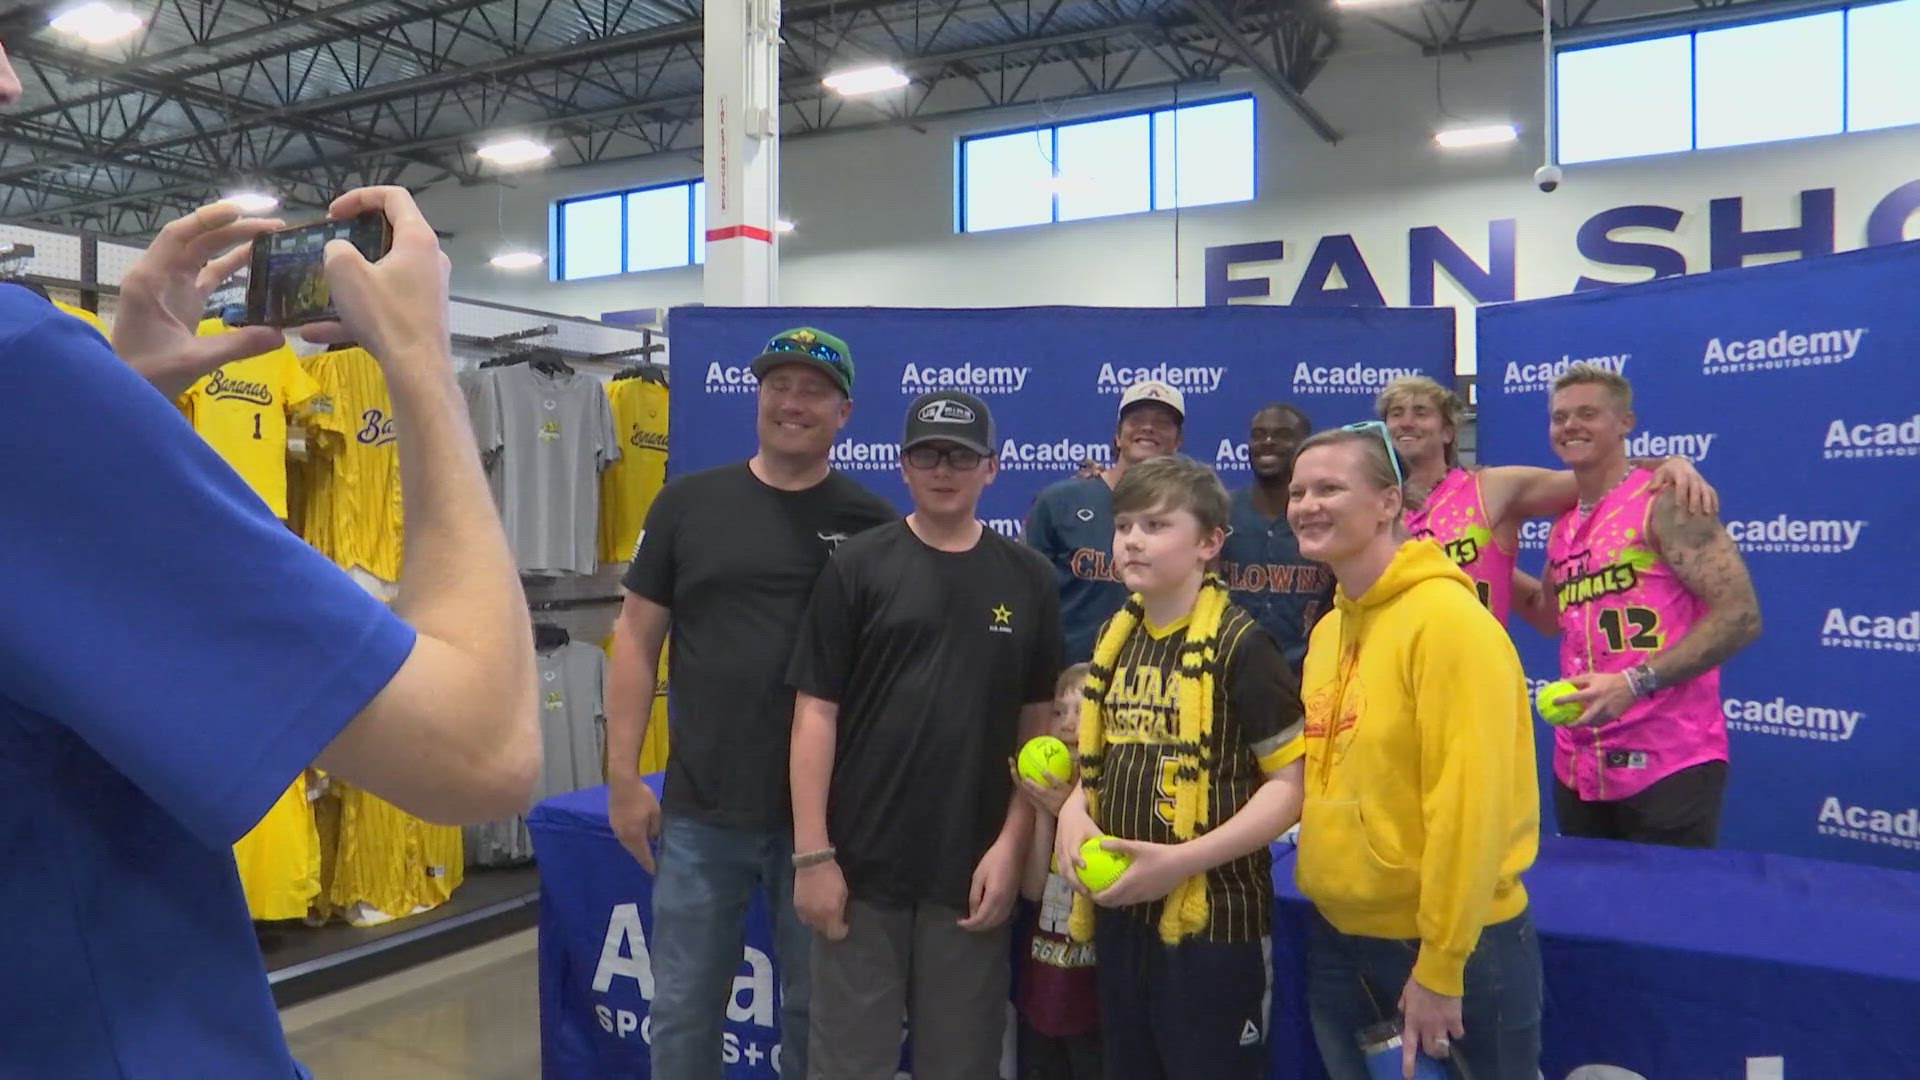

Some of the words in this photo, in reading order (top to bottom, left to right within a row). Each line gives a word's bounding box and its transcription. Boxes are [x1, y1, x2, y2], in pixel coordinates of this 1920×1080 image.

[1205, 218, 1516, 307] FAN
[1703, 328, 1864, 365] Academy
[901, 361, 1028, 391] Academy
[1097, 362, 1223, 391] Academy
[1702, 354, 1843, 376] SPORTS+OUTDOORS
[205, 369, 273, 406] Bananas
[252, 412, 262, 440] 1
[1824, 414, 1920, 448] Acad
[1000, 438, 1111, 461] Academ
[1726, 514, 1863, 550] cademy
[1599, 607, 1660, 652] 12
[1823, 608, 1920, 640] Acad
[1723, 697, 1861, 740] cademy
[1818, 796, 1919, 838] Acad
